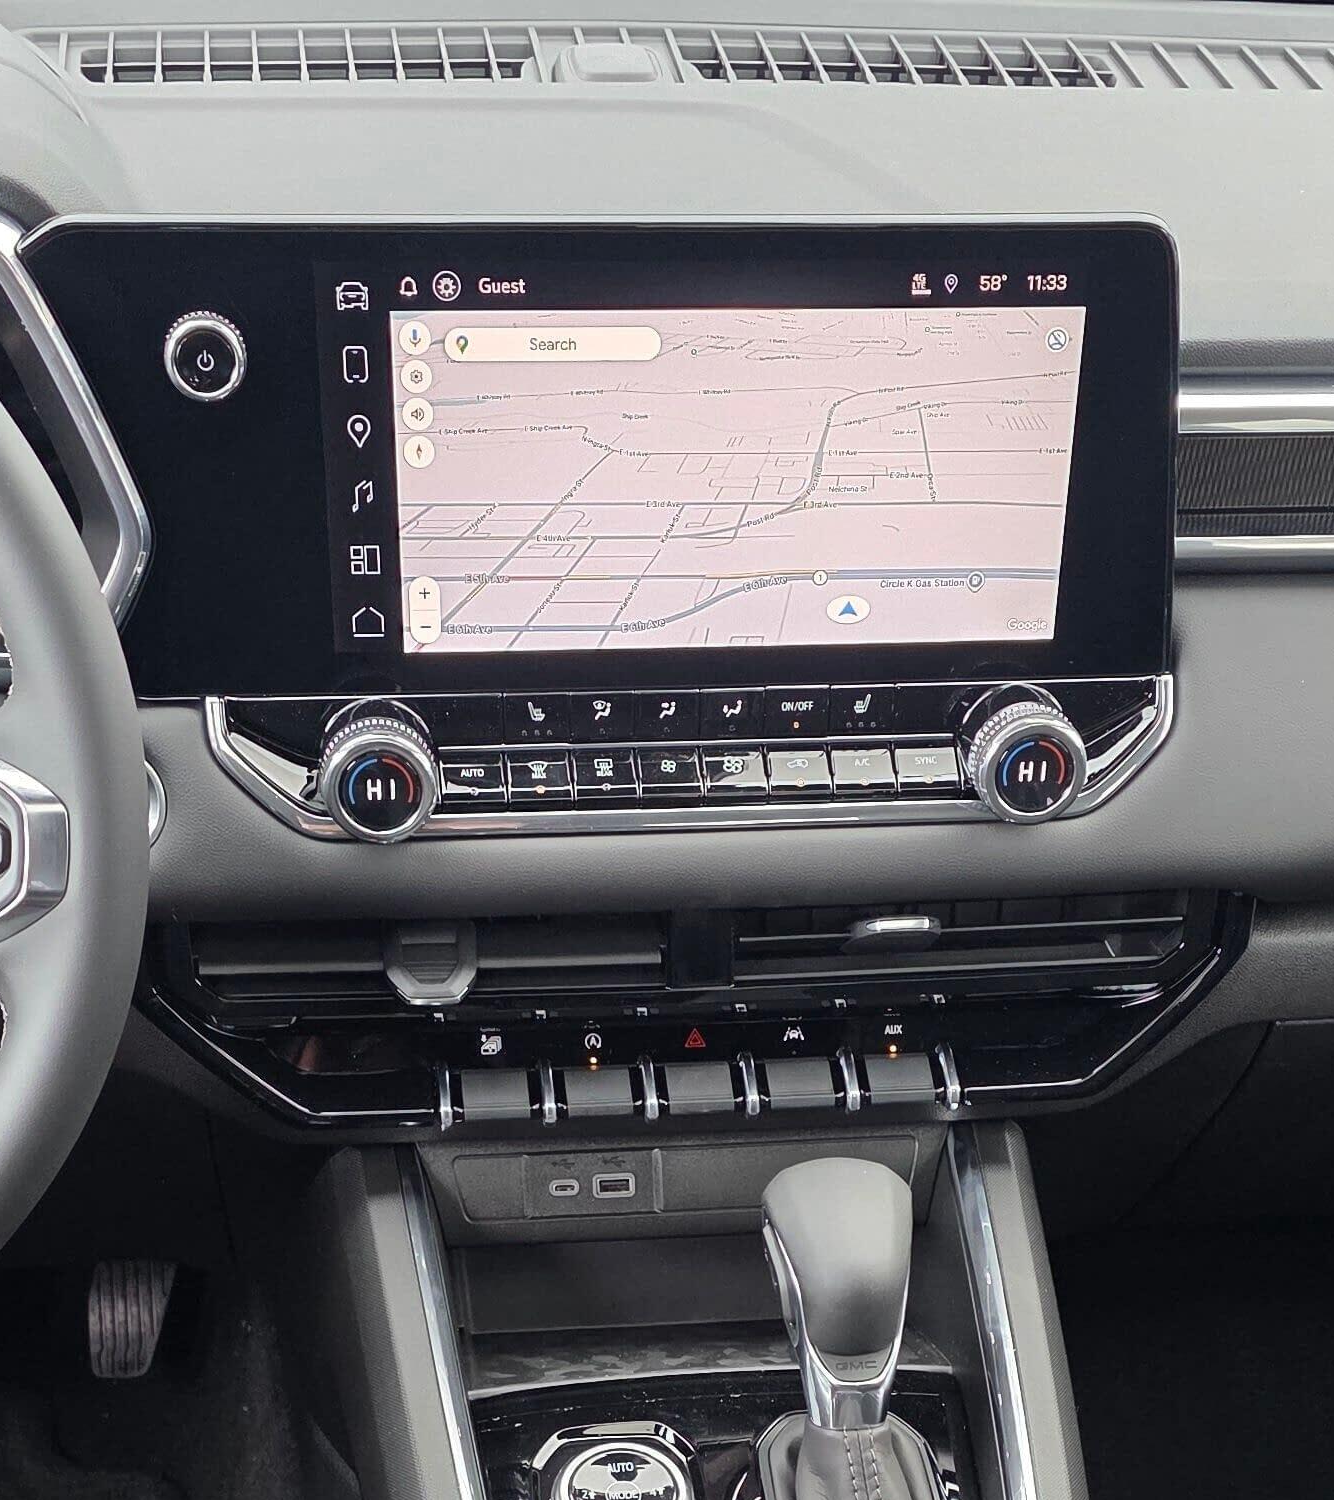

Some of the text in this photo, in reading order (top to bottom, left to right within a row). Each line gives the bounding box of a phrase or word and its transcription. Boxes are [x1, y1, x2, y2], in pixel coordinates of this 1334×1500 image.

[478, 278, 526, 294] Guest
[979, 274, 1008, 291] 58°
[1027, 274, 1068, 291] 11:33
[529, 337, 577, 351] Search
[880, 579, 905, 588] Circle
[934, 578, 965, 588] Station
[1007, 618, 1048, 631] Google
[781, 701, 814, 712] ON/OFF
[854, 758, 871, 767] A/C
[914, 755, 938, 765] SYNC
[460, 768, 485, 778] AUTO
[1018, 761, 1047, 782] HI
[366, 778, 396, 801] HI
[884, 1024, 903, 1035] AUX
[608, 1462, 635, 1473] AUTO
[608, 1490, 639, 1500] MODE
